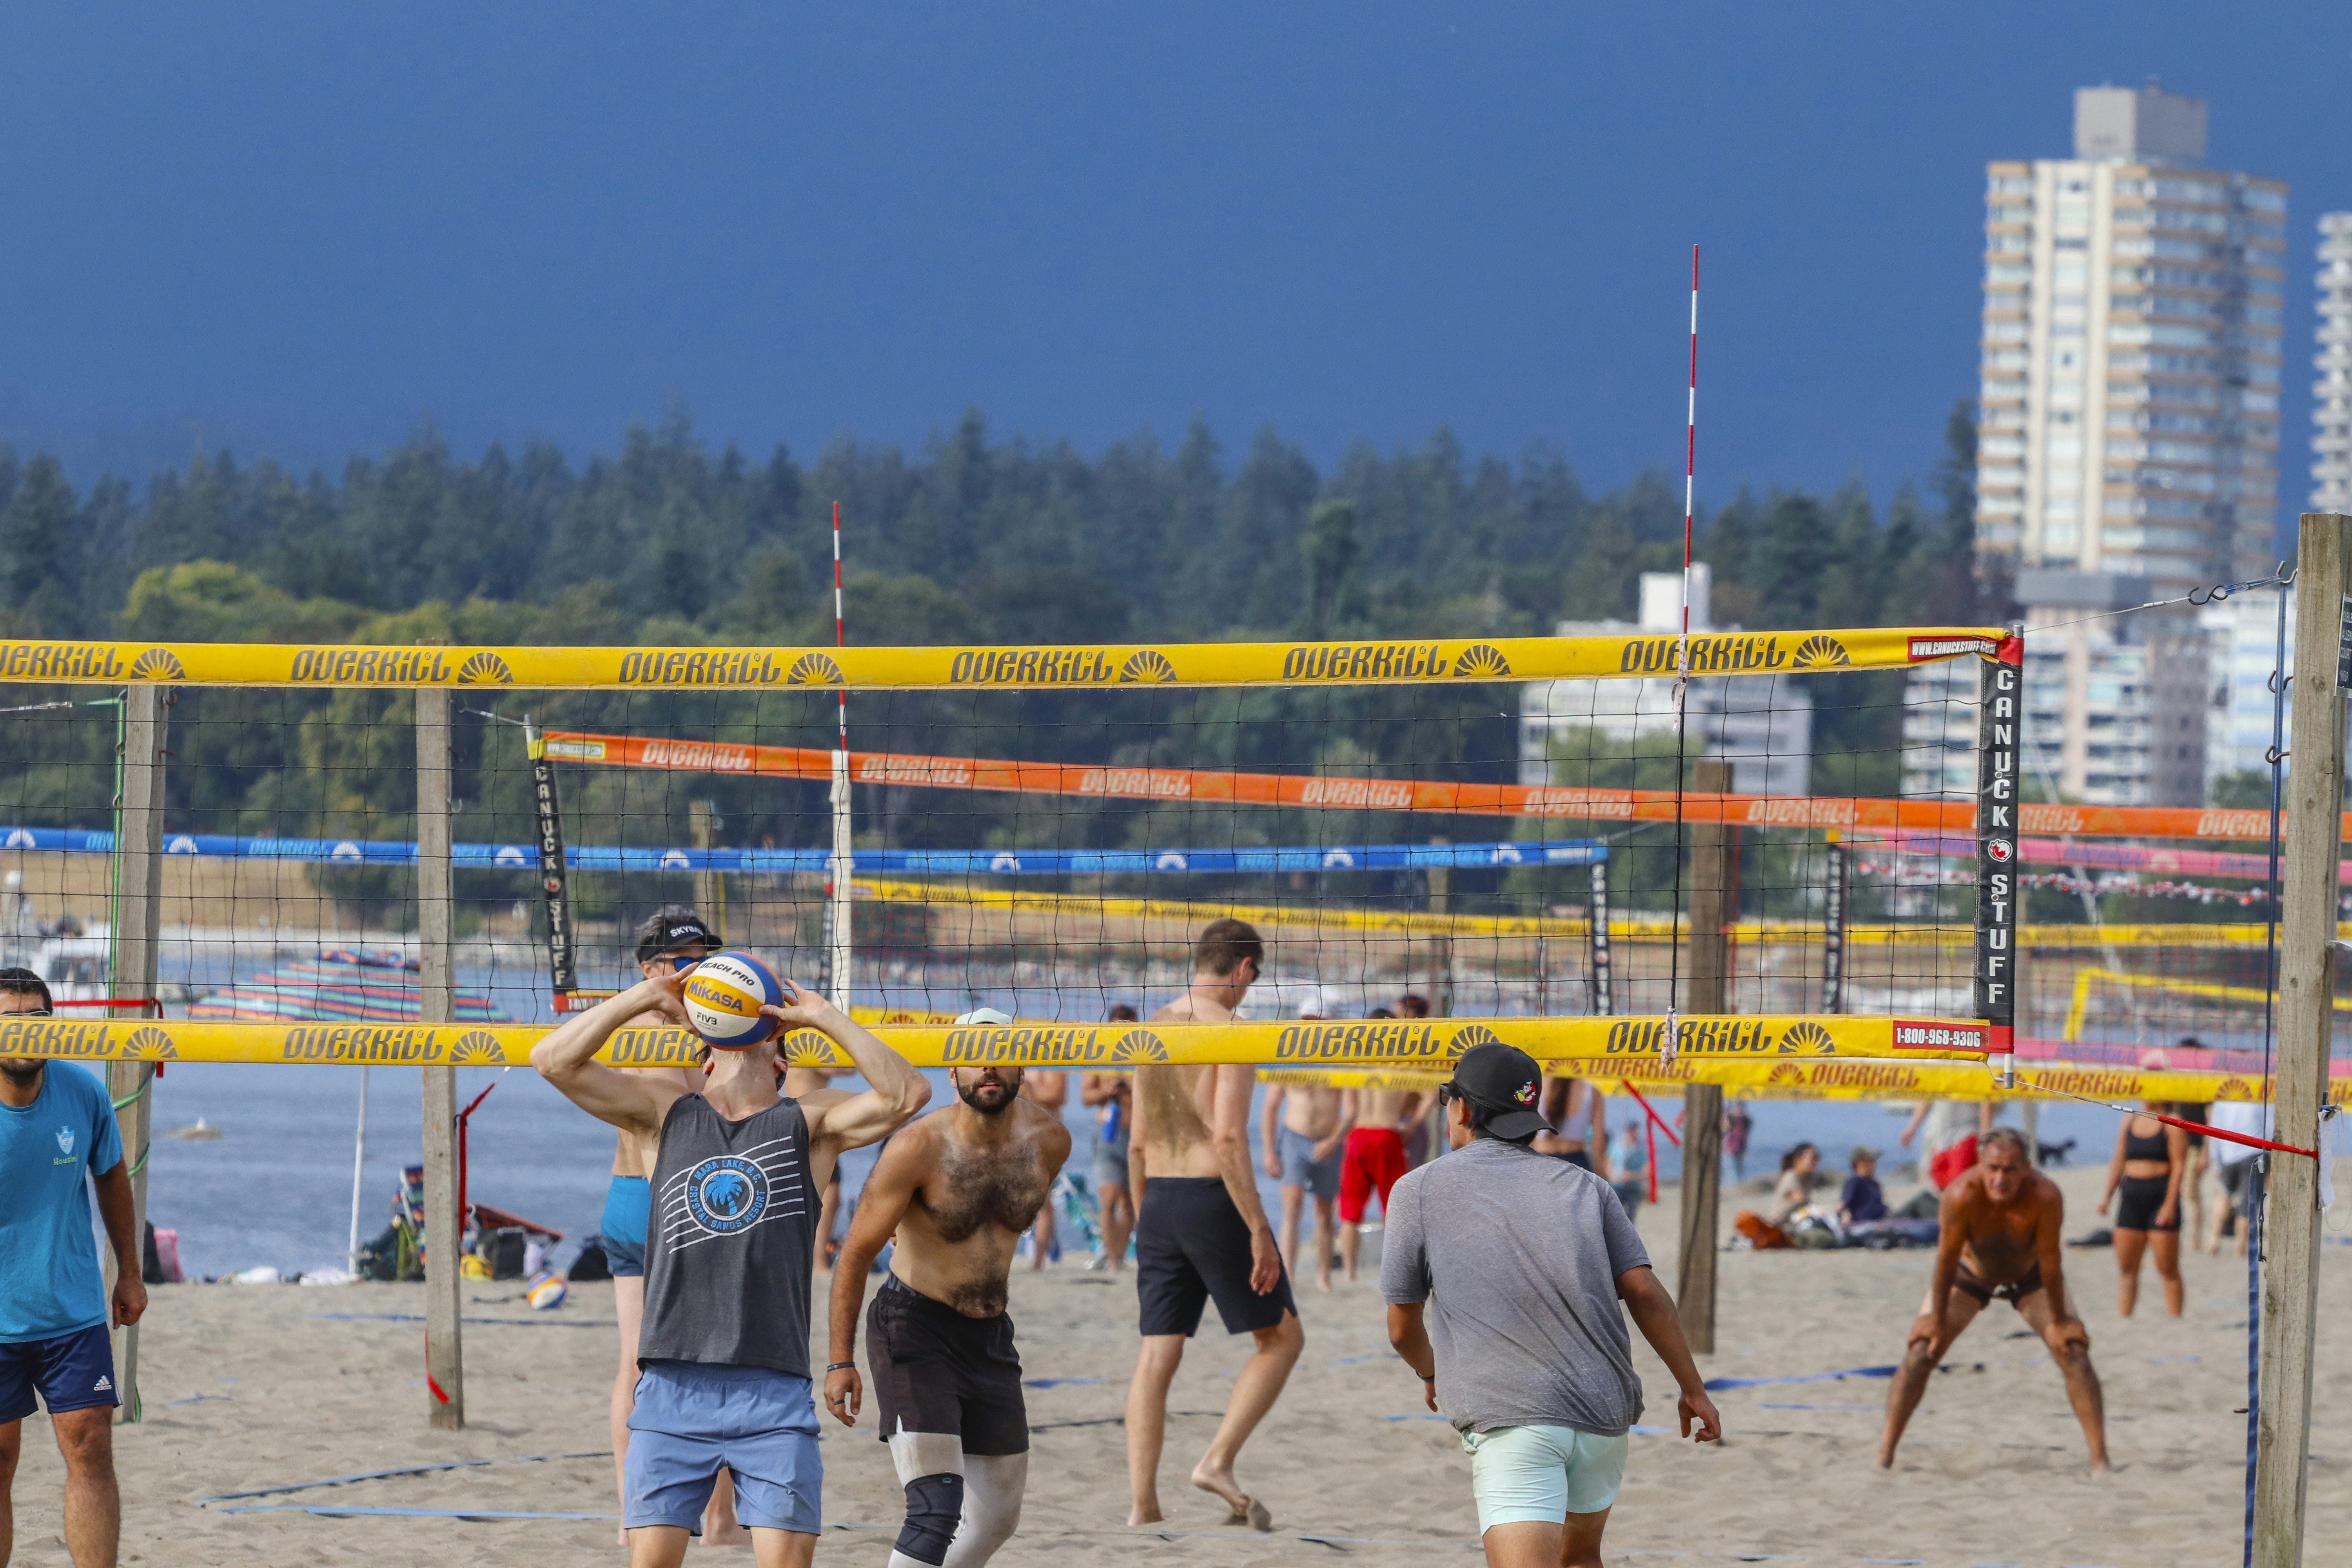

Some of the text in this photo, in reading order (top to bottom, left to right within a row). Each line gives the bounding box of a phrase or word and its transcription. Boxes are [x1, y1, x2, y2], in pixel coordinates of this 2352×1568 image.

[1993, 670, 2014, 827] CANUCK
[1989, 874, 2009, 1004] STUFF
[700, 962, 755, 986] BEACH PRO
[697, 1012, 717, 1025] FIVB
[1896, 1027, 1981, 1048] 1-800-968-9306
[694, 1161, 719, 1180] MARA
[722, 1160, 745, 1171] LAKE,
[689, 1186, 765, 1230] CRYSTAL SANDS RESORT
